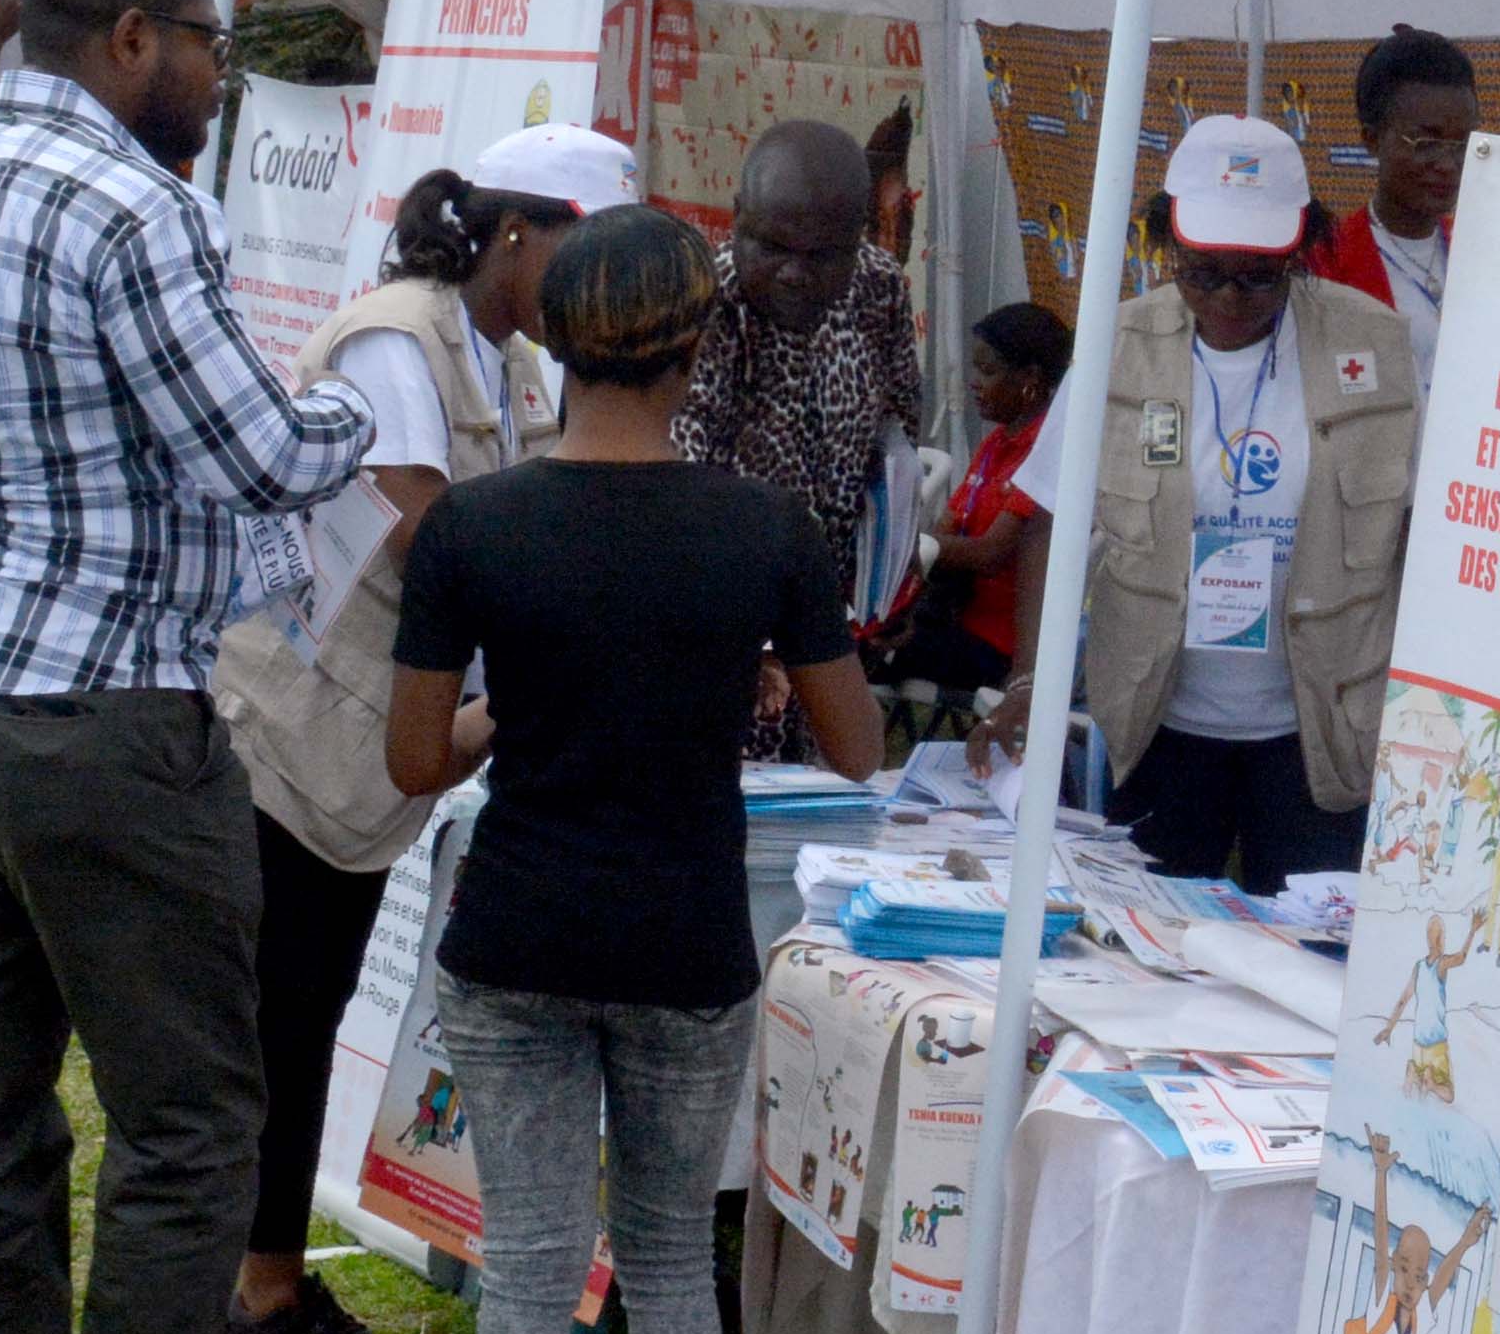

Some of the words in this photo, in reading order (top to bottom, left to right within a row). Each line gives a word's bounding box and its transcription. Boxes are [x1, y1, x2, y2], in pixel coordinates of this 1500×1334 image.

[250, 129, 343, 193] Cordaid
[1476, 427, 1499, 469] ET
[1201, 577, 1263, 589] EXPOSANT
[1458, 543, 1497, 594] DES
[380, 895, 399, 917] aire
[374, 927, 392, 945] voir
[382, 958, 416, 989] Mouve
[357, 981, 400, 1017] x-Rouge
